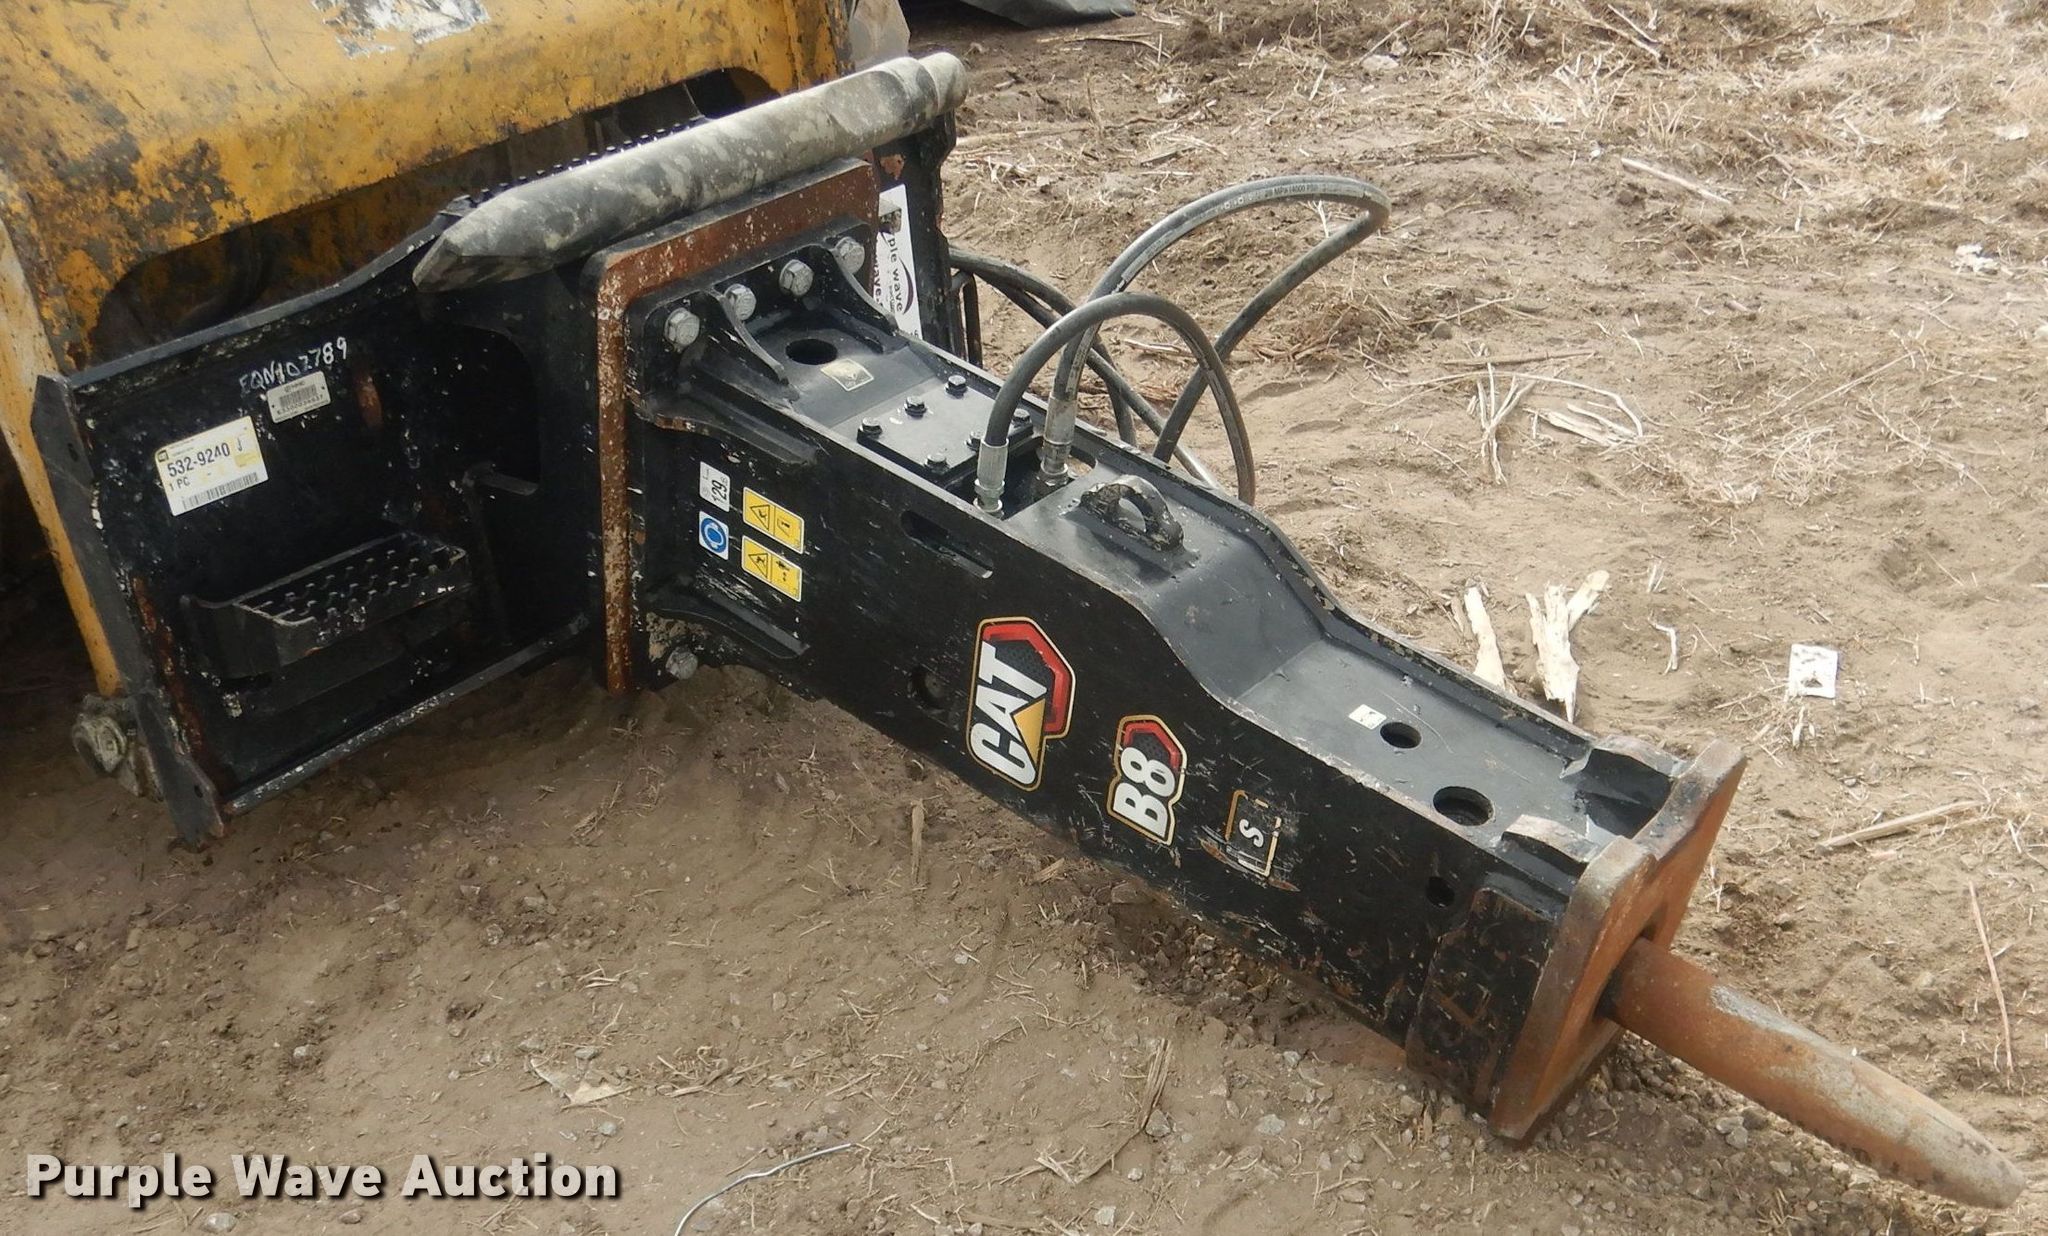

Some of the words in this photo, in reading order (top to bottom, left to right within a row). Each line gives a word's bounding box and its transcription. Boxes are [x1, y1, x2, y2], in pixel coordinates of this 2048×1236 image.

[892, 268, 904, 313] wave
[167, 442, 231, 478] 532-9240
[176, 477, 191, 489] PC
[970, 640, 1048, 785] CAT
[1112, 746, 1176, 839] B8
[1239, 818, 1264, 848] S
